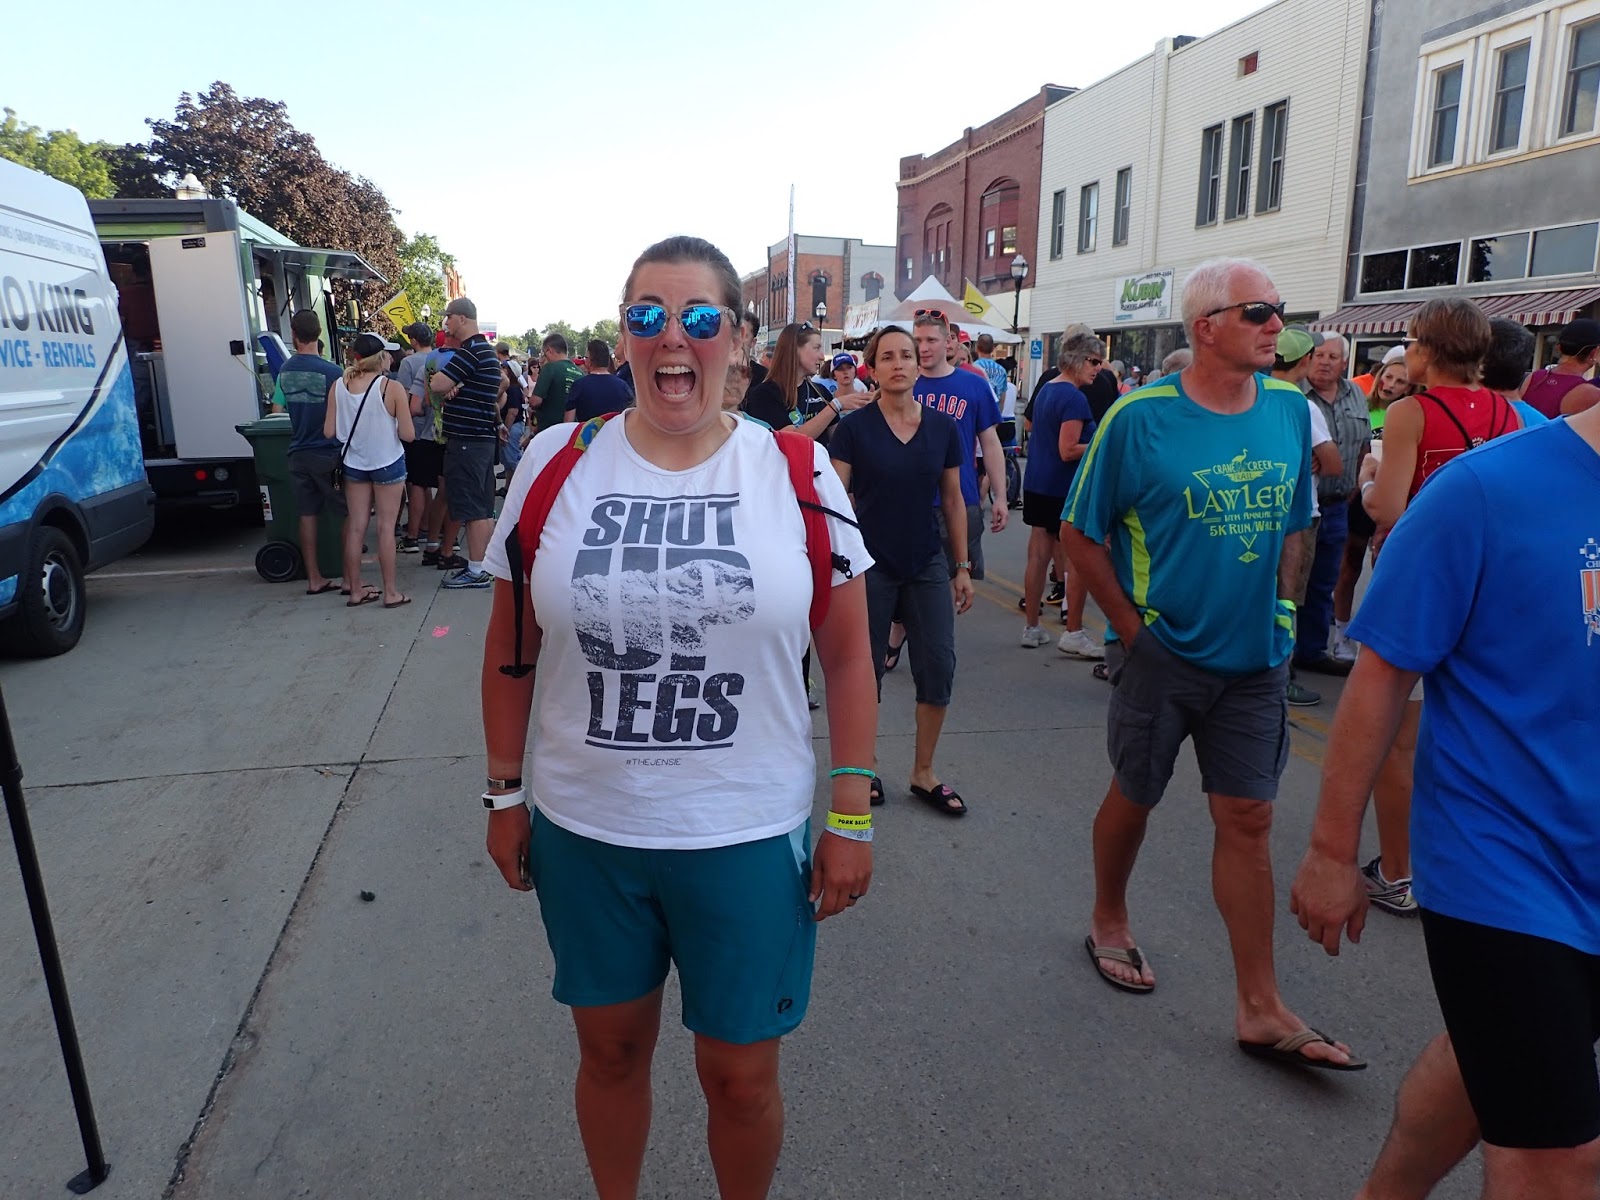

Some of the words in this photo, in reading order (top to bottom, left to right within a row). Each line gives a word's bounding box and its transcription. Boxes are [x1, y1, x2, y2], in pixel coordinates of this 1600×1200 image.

[1121, 278, 1163, 302] KUBIK
[28, 280, 95, 336] KING
[42, 341, 97, 369] RENTALS
[912, 393, 967, 419] ICAGO
[1212, 463, 1236, 475] CRANE
[1247, 460, 1274, 472] CREEK
[1232, 472, 1255, 481] TRAIL
[1183, 478, 1294, 519] LAWLER'S
[582, 499, 740, 547] SHUT
[1243, 511, 1272, 520] ANNUAL
[1210, 525, 1227, 537] 5K
[570, 546, 756, 672] UP
[586, 671, 745, 744] LEGS
